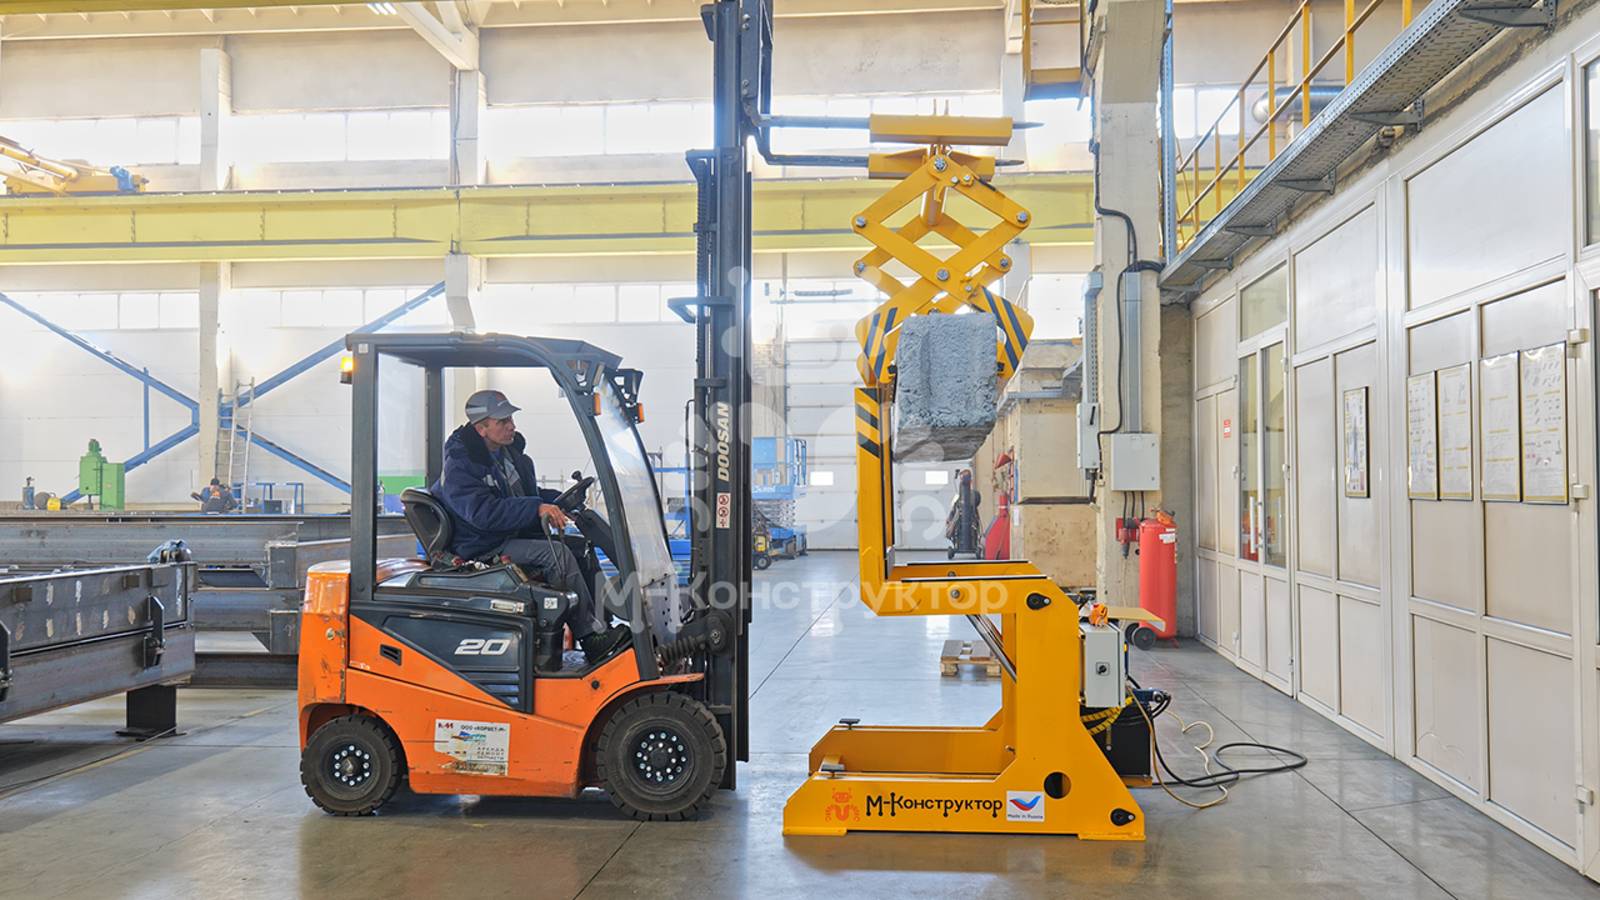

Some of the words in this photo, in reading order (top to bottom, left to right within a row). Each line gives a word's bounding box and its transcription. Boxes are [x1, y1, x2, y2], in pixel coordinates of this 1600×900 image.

[717, 402, 730, 481] DOOSAN
[454, 639, 511, 655] 20
[866, 792, 1003, 818] М-Конструктор
